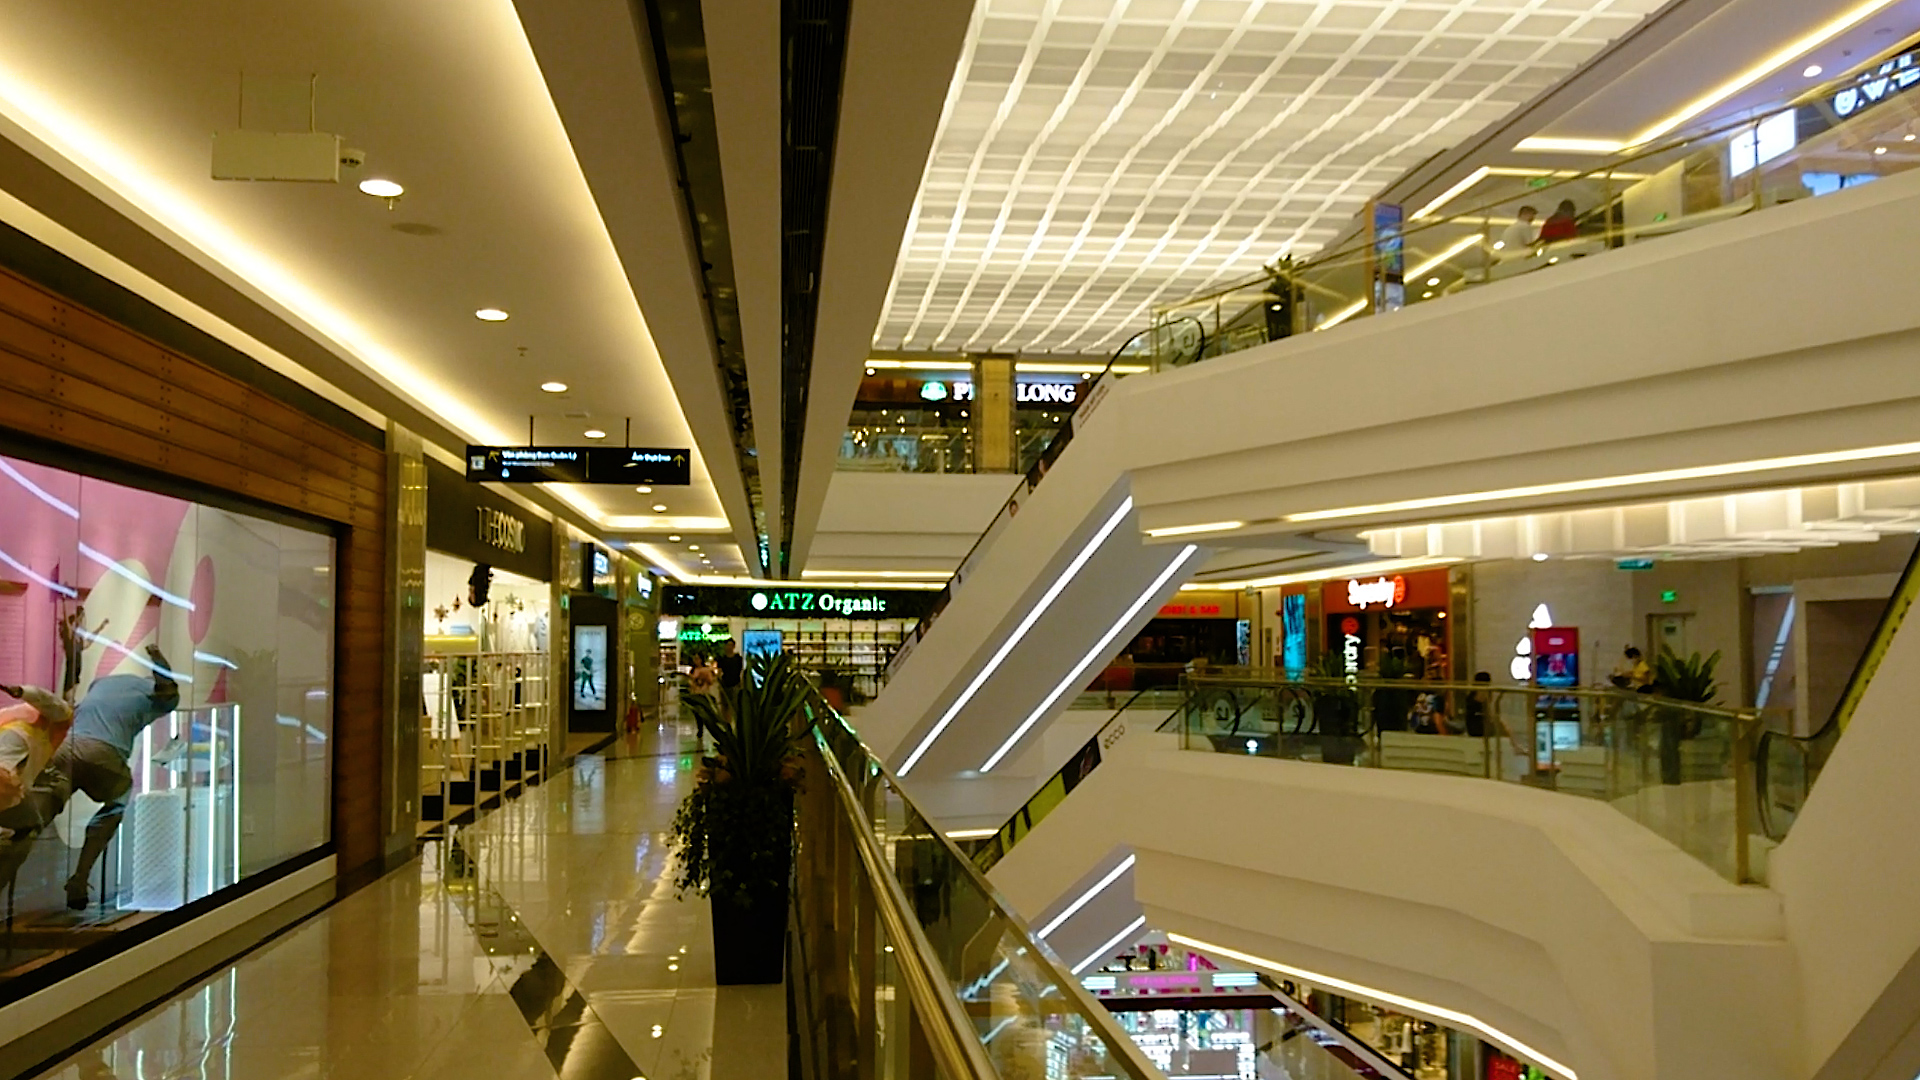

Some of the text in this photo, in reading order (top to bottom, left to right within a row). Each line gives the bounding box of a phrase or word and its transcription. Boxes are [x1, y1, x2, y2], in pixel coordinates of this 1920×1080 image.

[1016, 383, 1077, 403] LONG
[769, 592, 887, 615] ATZ Organic
